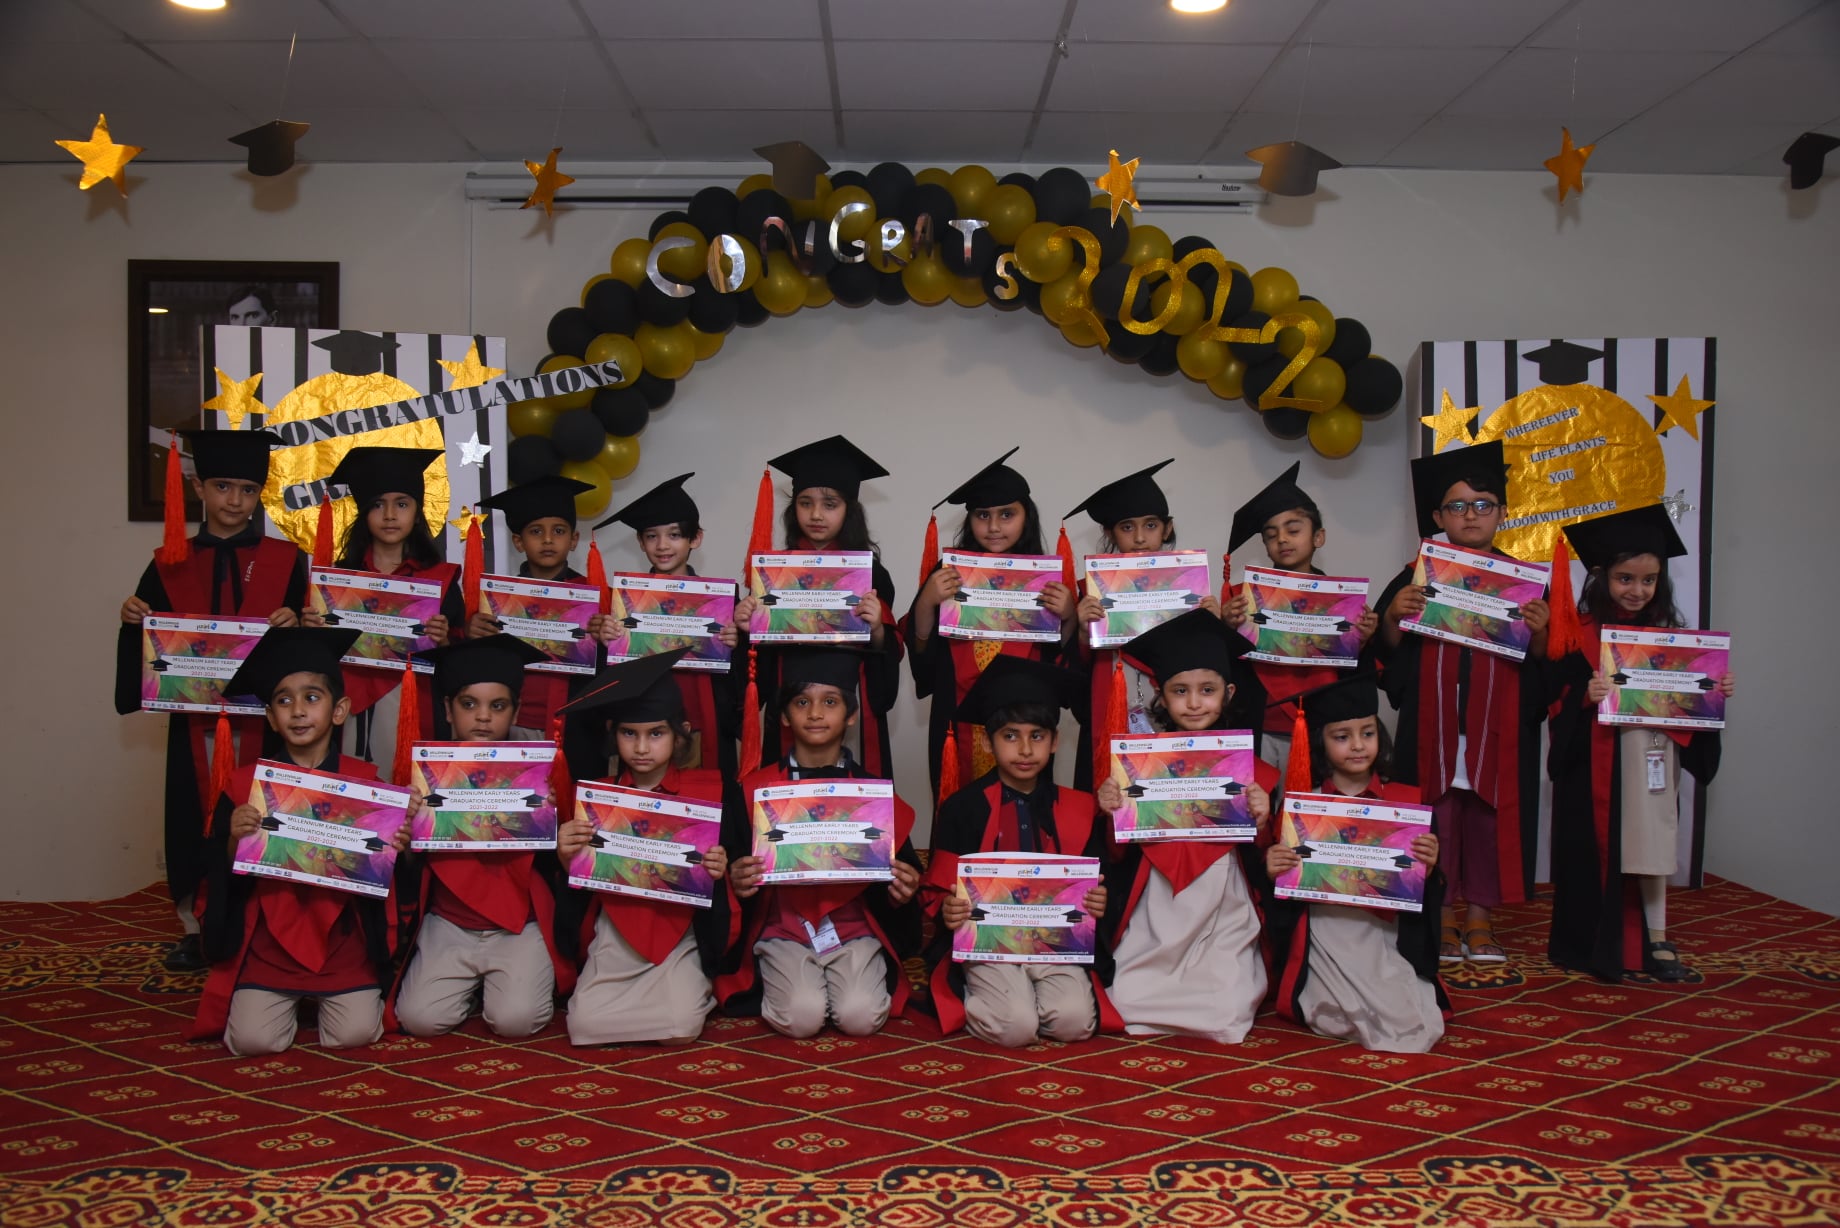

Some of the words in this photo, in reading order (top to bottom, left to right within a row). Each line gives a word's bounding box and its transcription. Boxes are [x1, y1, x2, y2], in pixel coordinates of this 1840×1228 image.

[646, 201, 1020, 299] CONGRATS
[1047, 225, 1326, 413] 2022
[1505, 407, 1579, 439] WHEREEVER
[1530, 449, 1557, 463] LIFE
[1560, 436, 1607, 456] PLANTS
[1549, 470, 1574, 483] YOU
[1500, 516, 1539, 531] BLOOM
[1541, 509, 1570, 522] WITH
[1573, 500, 1616, 515] GRACE
[287, 816, 324, 828] MILLENNIUM
[325, 824, 342, 832] EARLY
[344, 828, 363, 836] YEARS
[287, 825, 325, 837] GRADUATION
[326, 832, 360, 843] CEREMONY
[306, 835, 337, 846] 2021-2022
[611, 834, 645, 844] MILLENNIUM
[612, 842, 646, 852] GRADUATION
[648, 848, 679, 857] CEREMONY
[630, 851, 658, 860] 2021-2022
